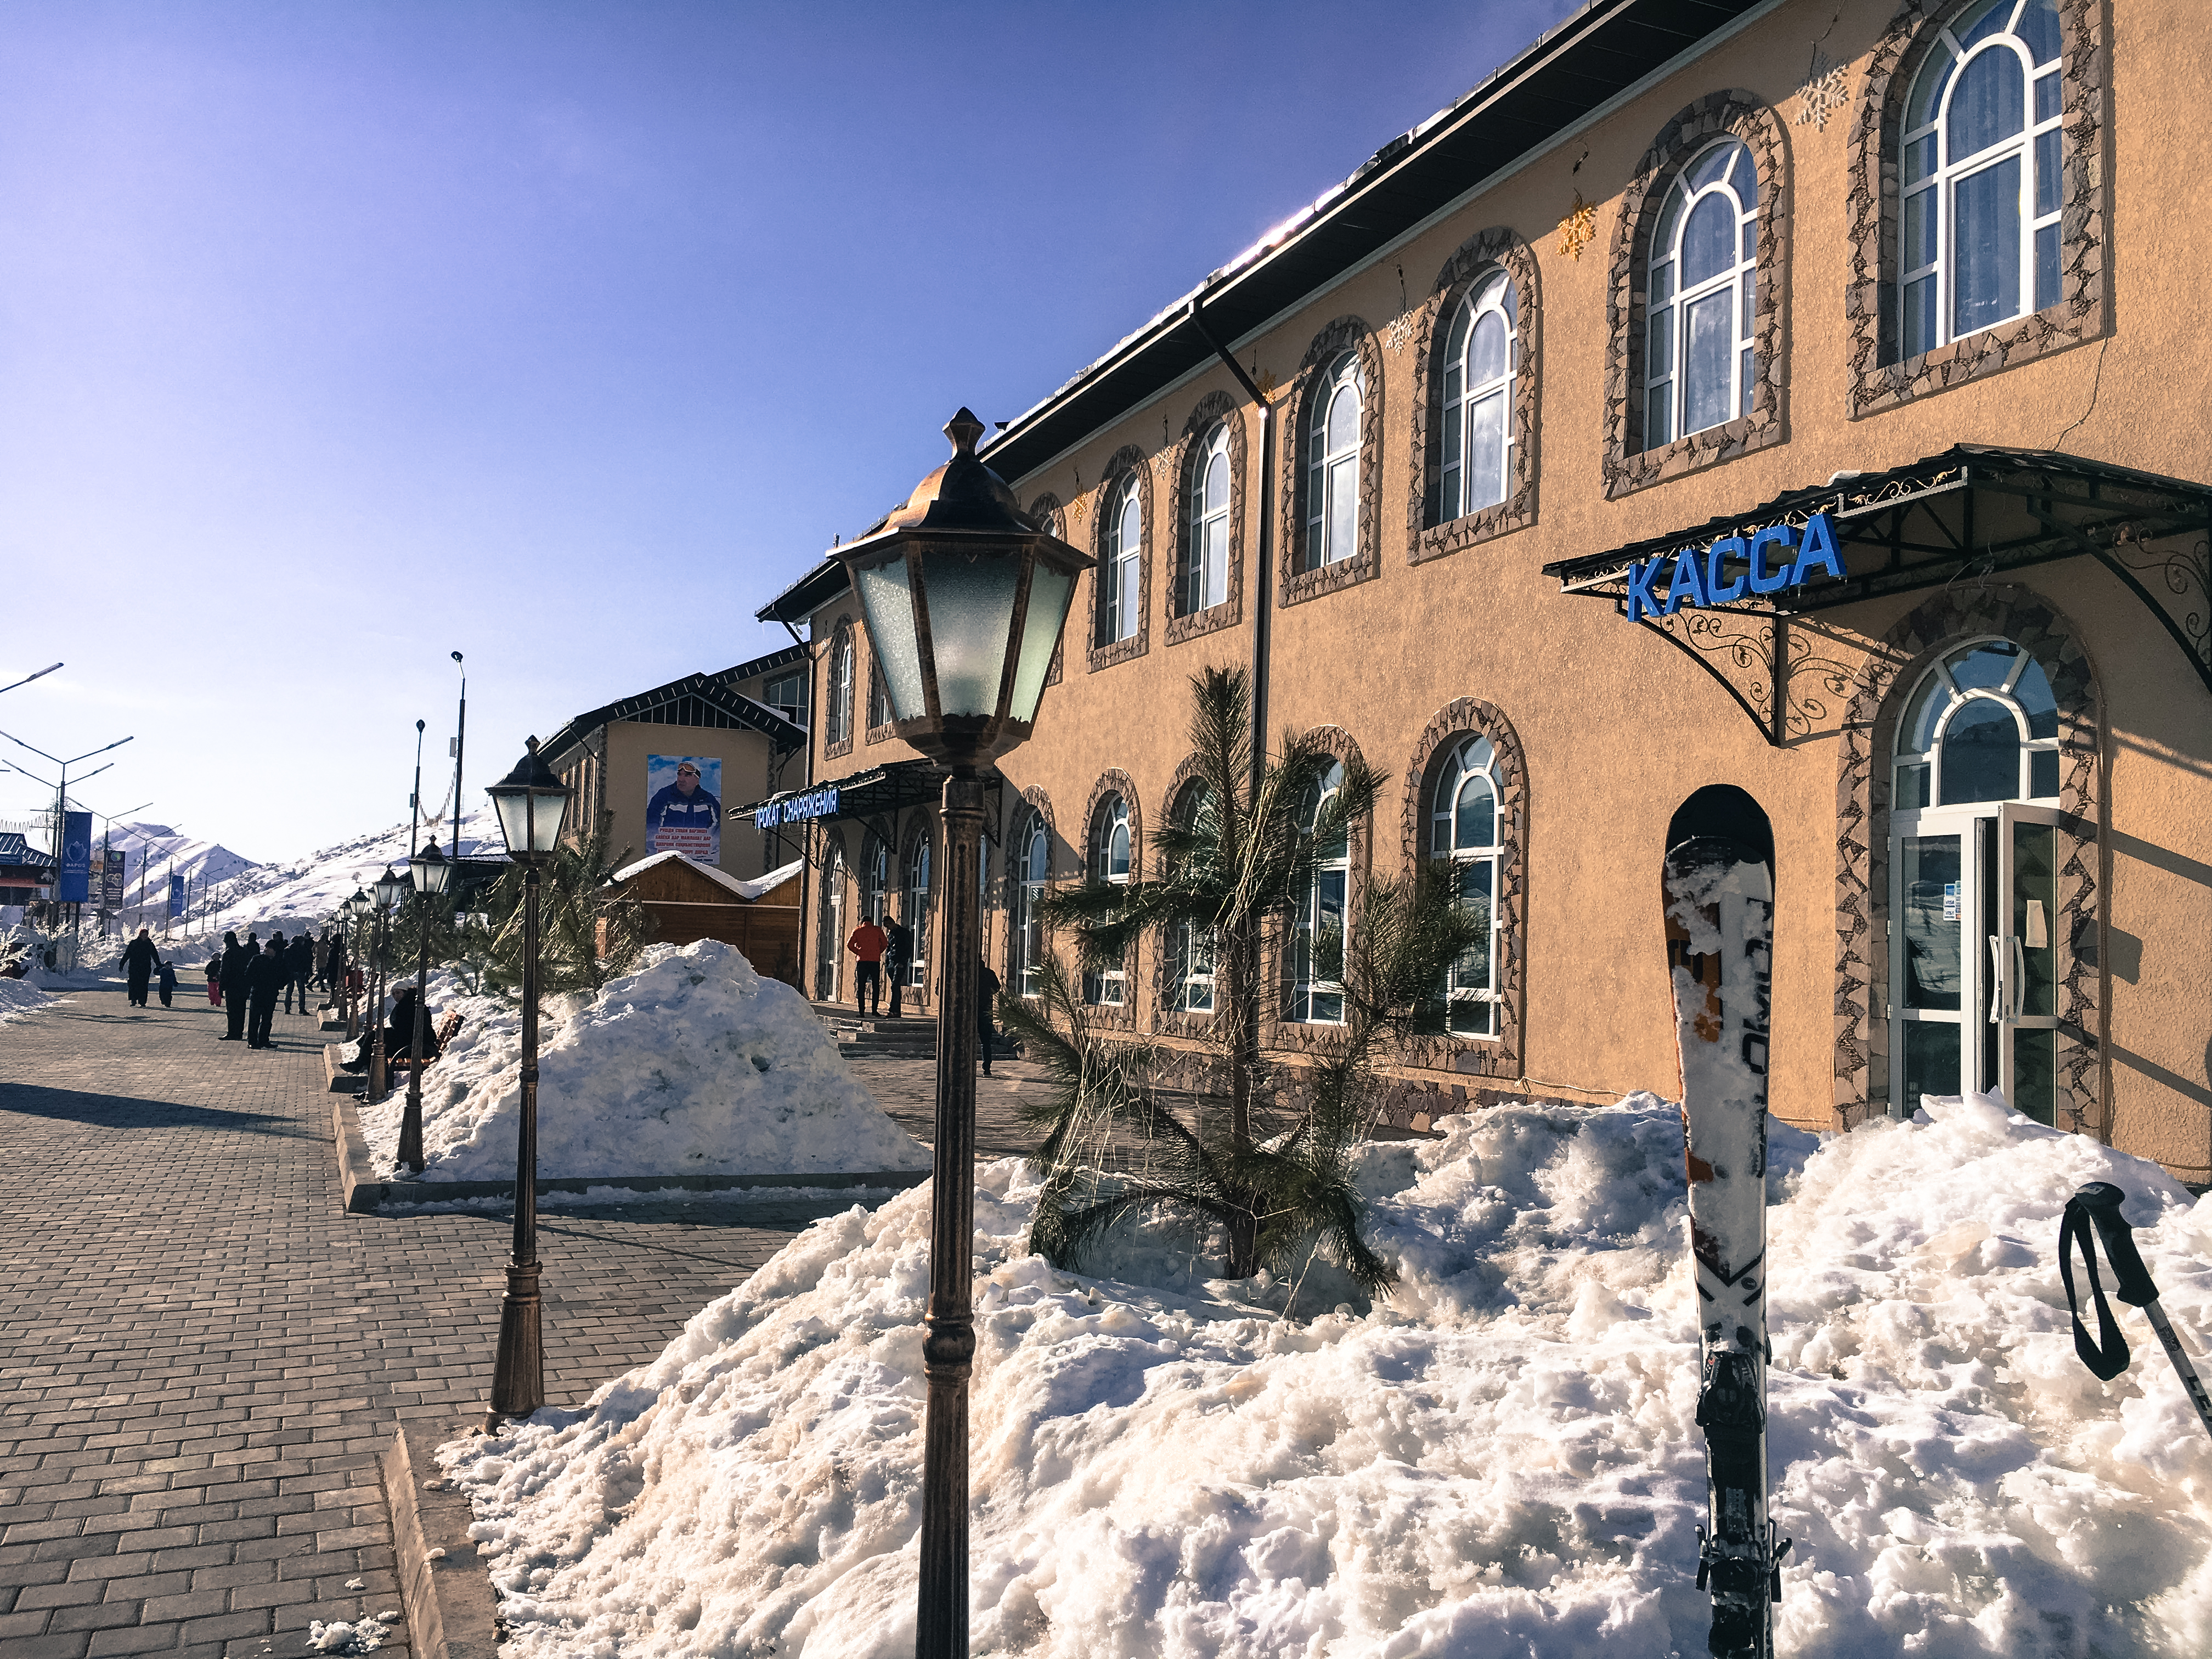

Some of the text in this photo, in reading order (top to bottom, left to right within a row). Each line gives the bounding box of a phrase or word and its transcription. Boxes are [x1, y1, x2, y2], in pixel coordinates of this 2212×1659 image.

[1627, 513, 1847, 622] КАССА
[755, 789, 839, 830] ПРОКАТ СНАРЯЖЕНИЯ
